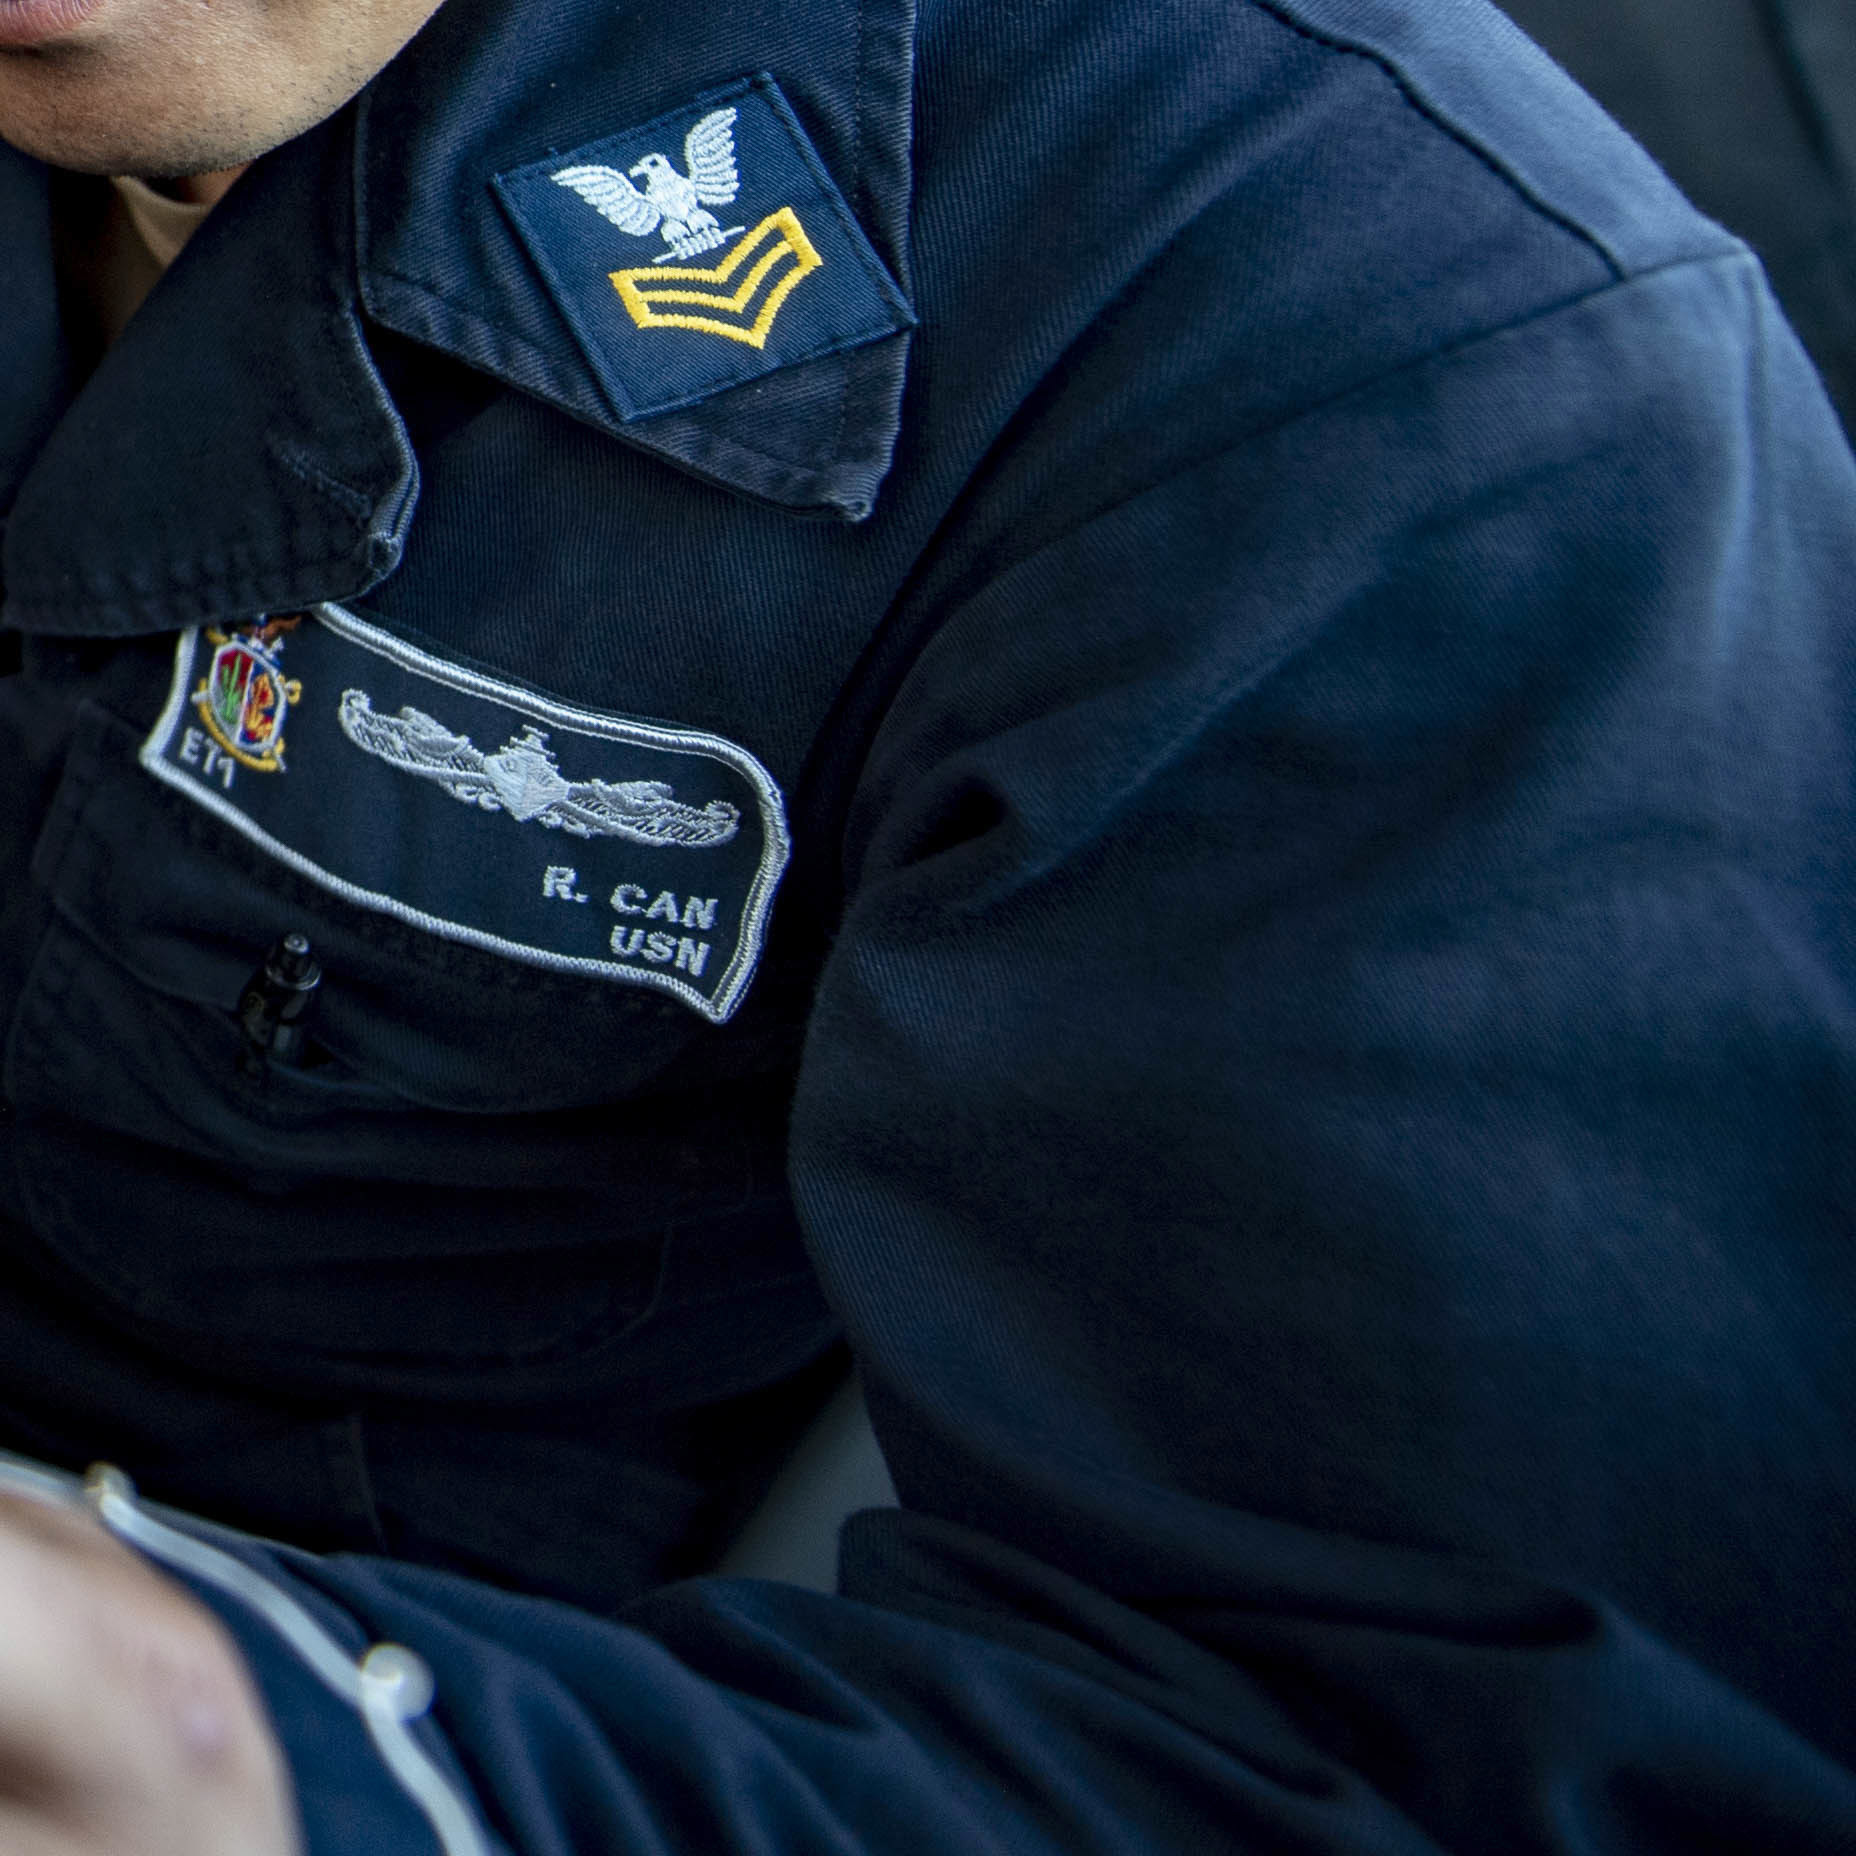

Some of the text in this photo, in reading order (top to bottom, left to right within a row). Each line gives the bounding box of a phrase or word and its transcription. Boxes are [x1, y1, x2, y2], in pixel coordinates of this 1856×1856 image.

[543, 865, 719, 930] R. CAN
[610, 925, 712, 977] USN
